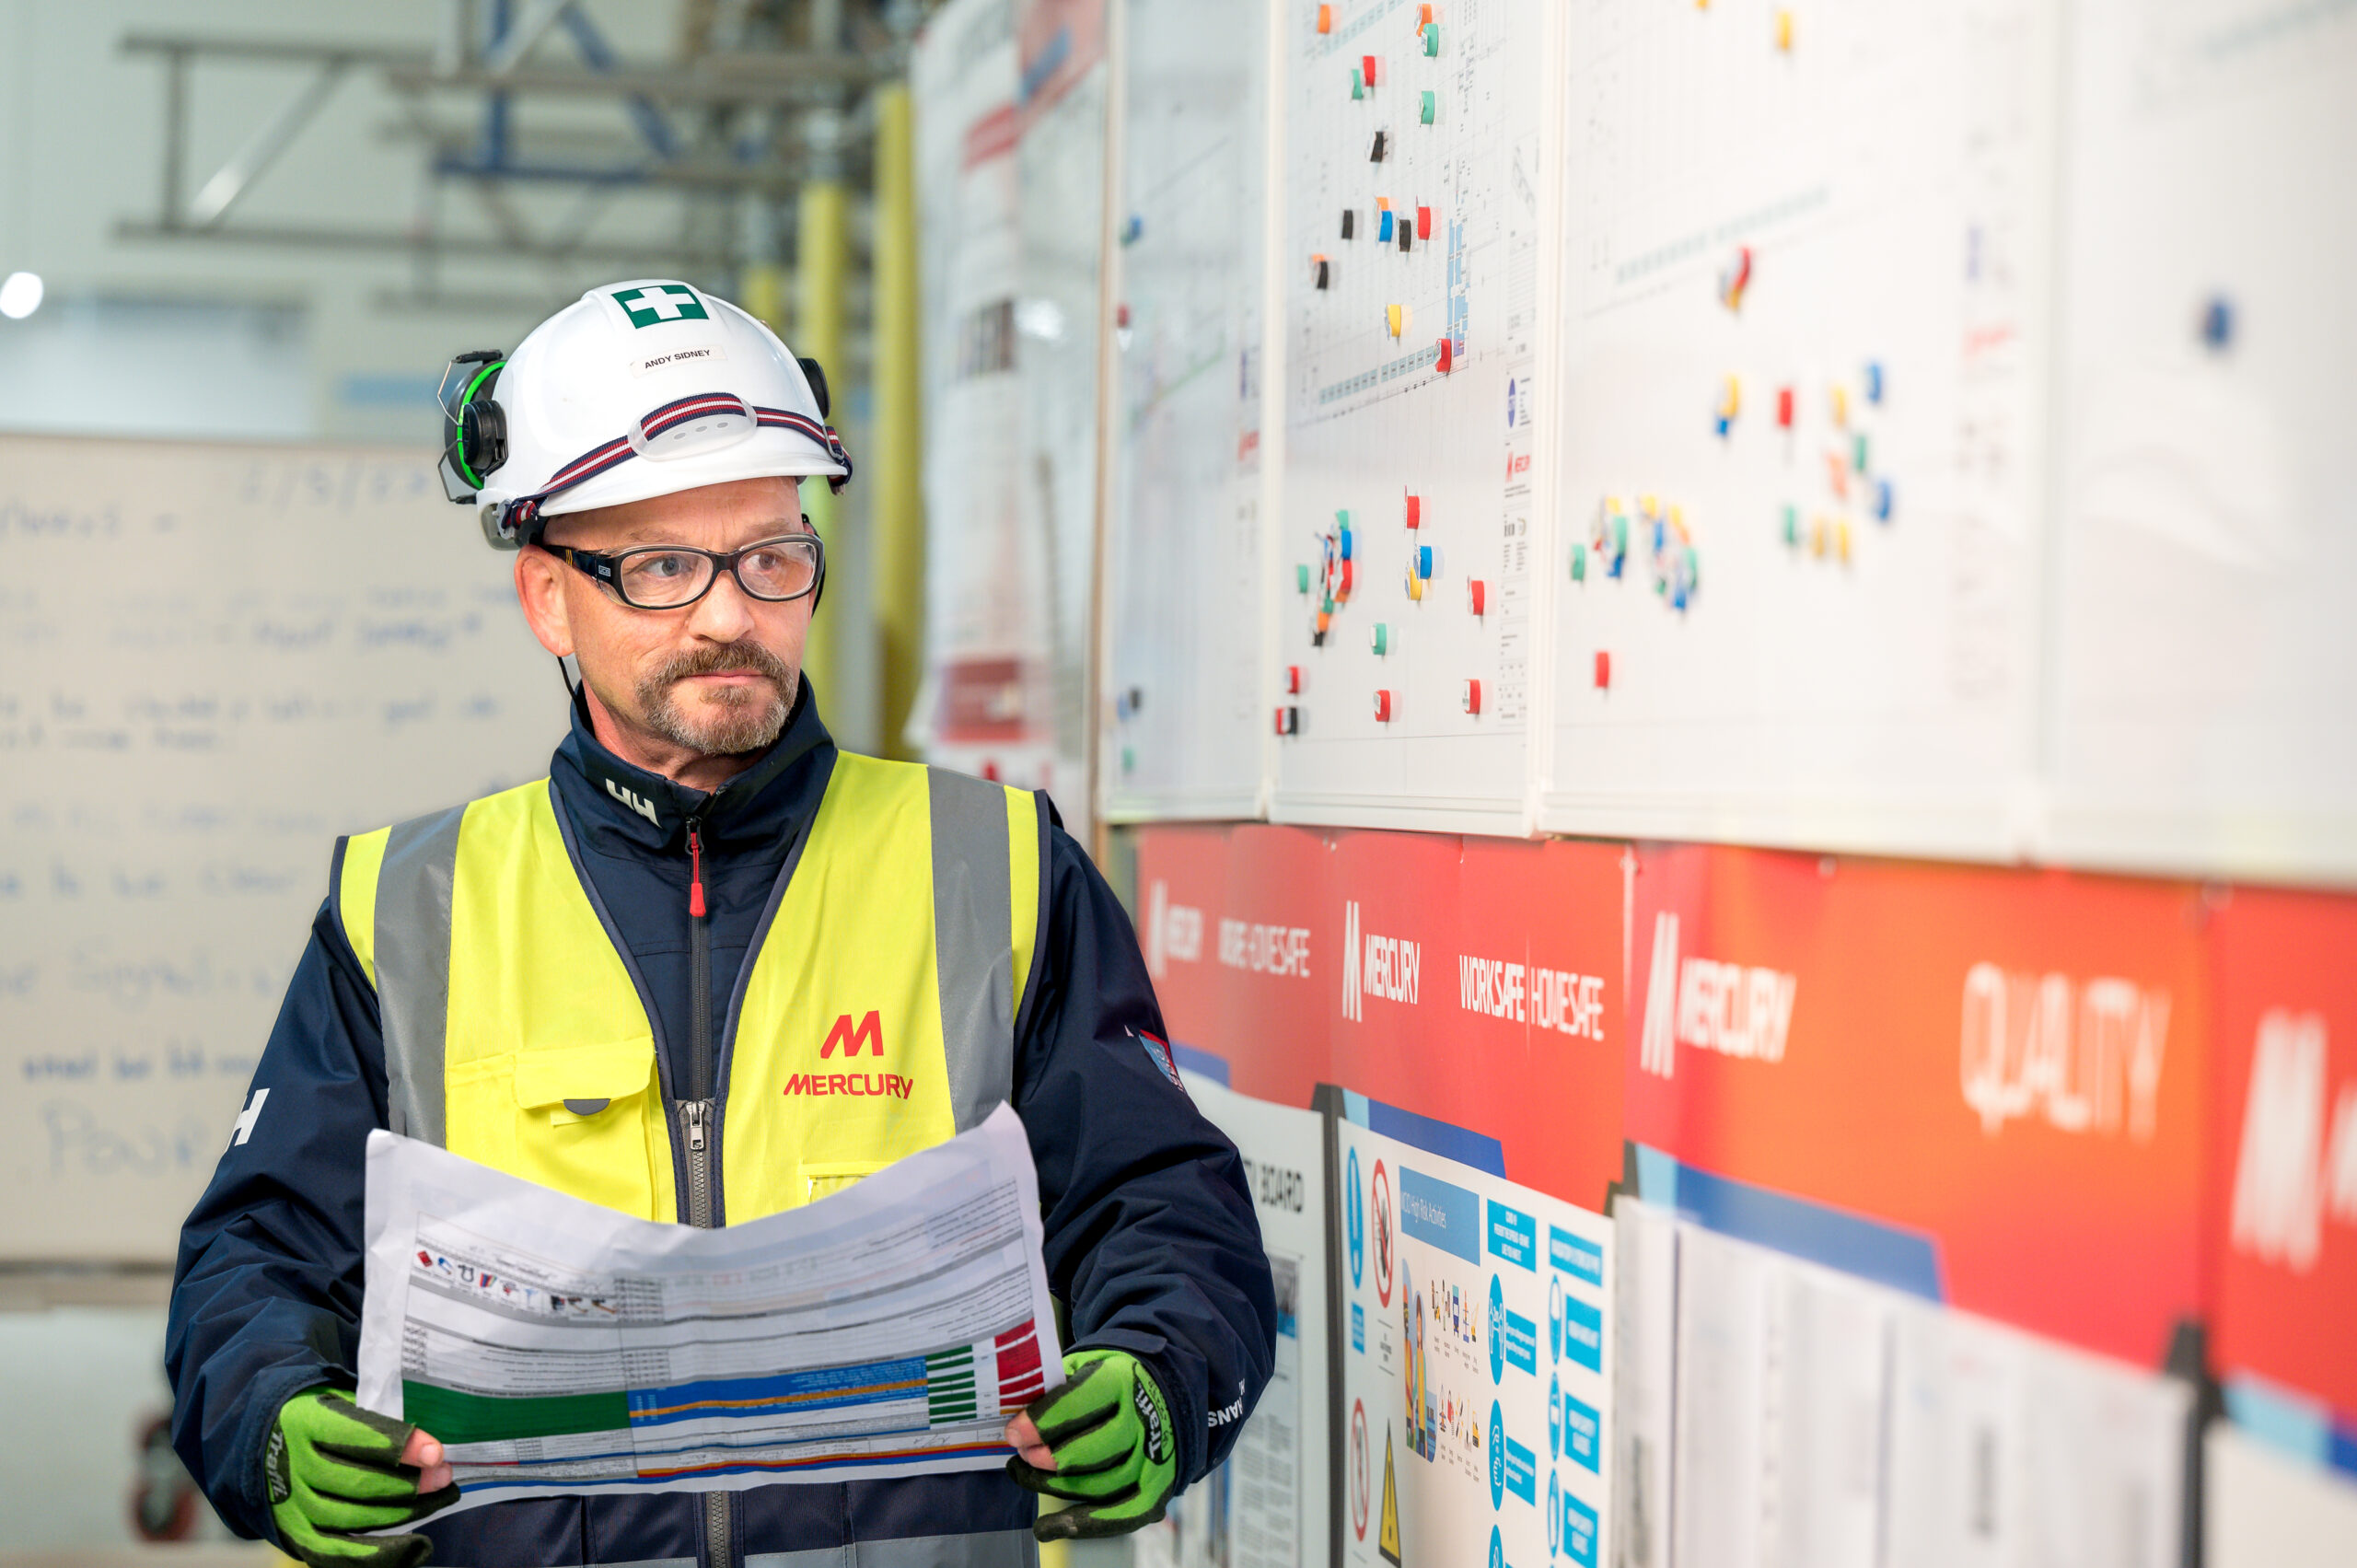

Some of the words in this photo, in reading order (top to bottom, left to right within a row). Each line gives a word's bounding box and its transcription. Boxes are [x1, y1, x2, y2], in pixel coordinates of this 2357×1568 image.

[645, 355, 671, 369] ANDY
[674, 349, 710, 361] SIDNEY
[1364, 933, 1420, 1005] MERCURY
[1459, 954, 1525, 1022] WORKSAFE
[1530, 966, 1605, 1042] HOMESAFE
[1959, 959, 2171, 1144] QUALITY
[784, 1073, 913, 1100] MERCURY
